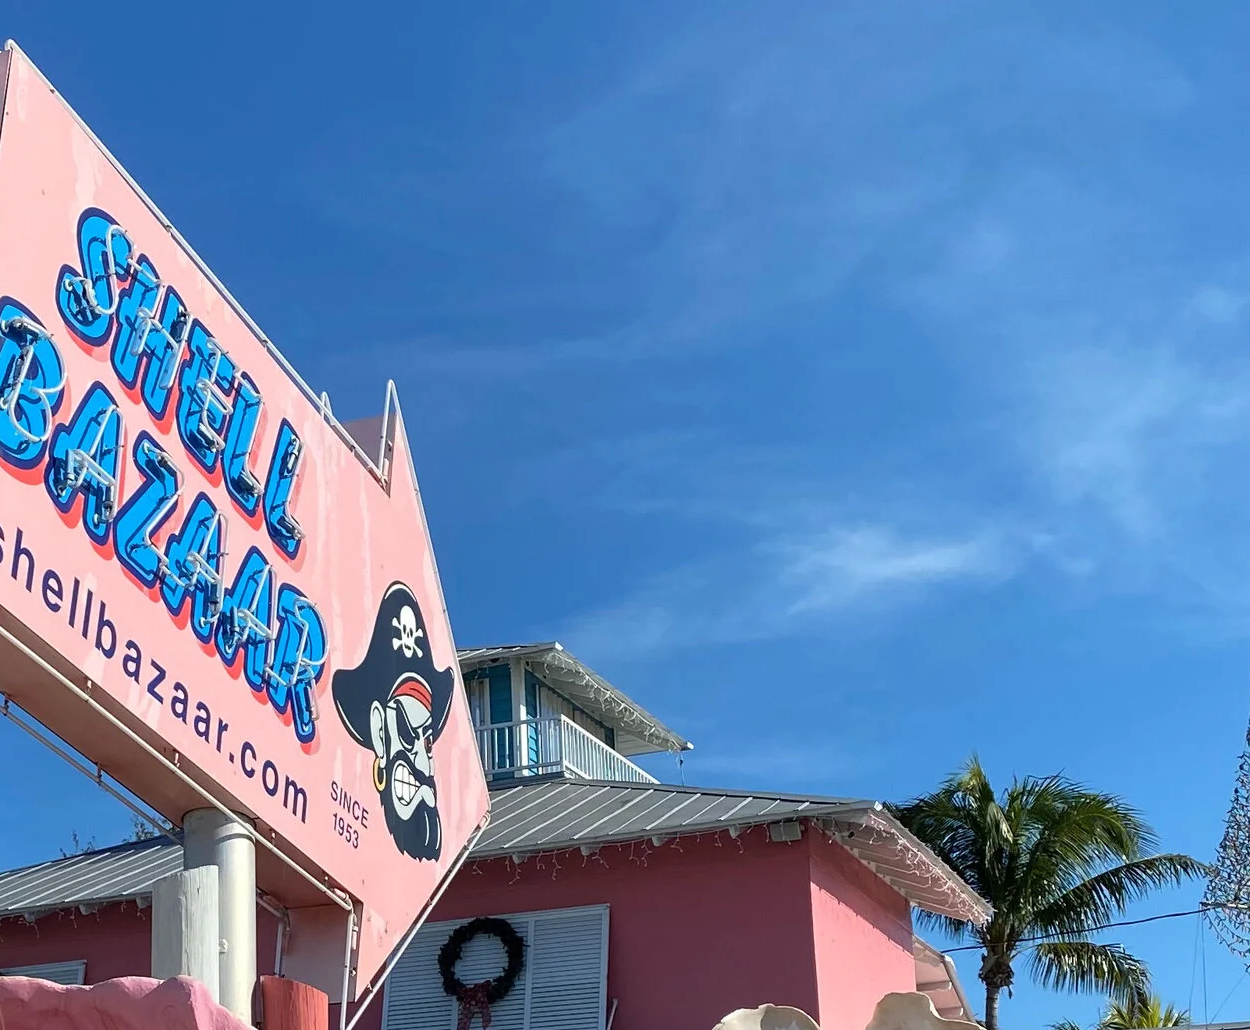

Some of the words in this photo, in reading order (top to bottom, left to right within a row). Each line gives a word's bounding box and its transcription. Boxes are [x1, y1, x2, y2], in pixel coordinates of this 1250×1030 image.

[55, 207, 305, 556] SHELL
[330, 780, 369, 829] SINCE
[332, 812, 360, 849] 1953
